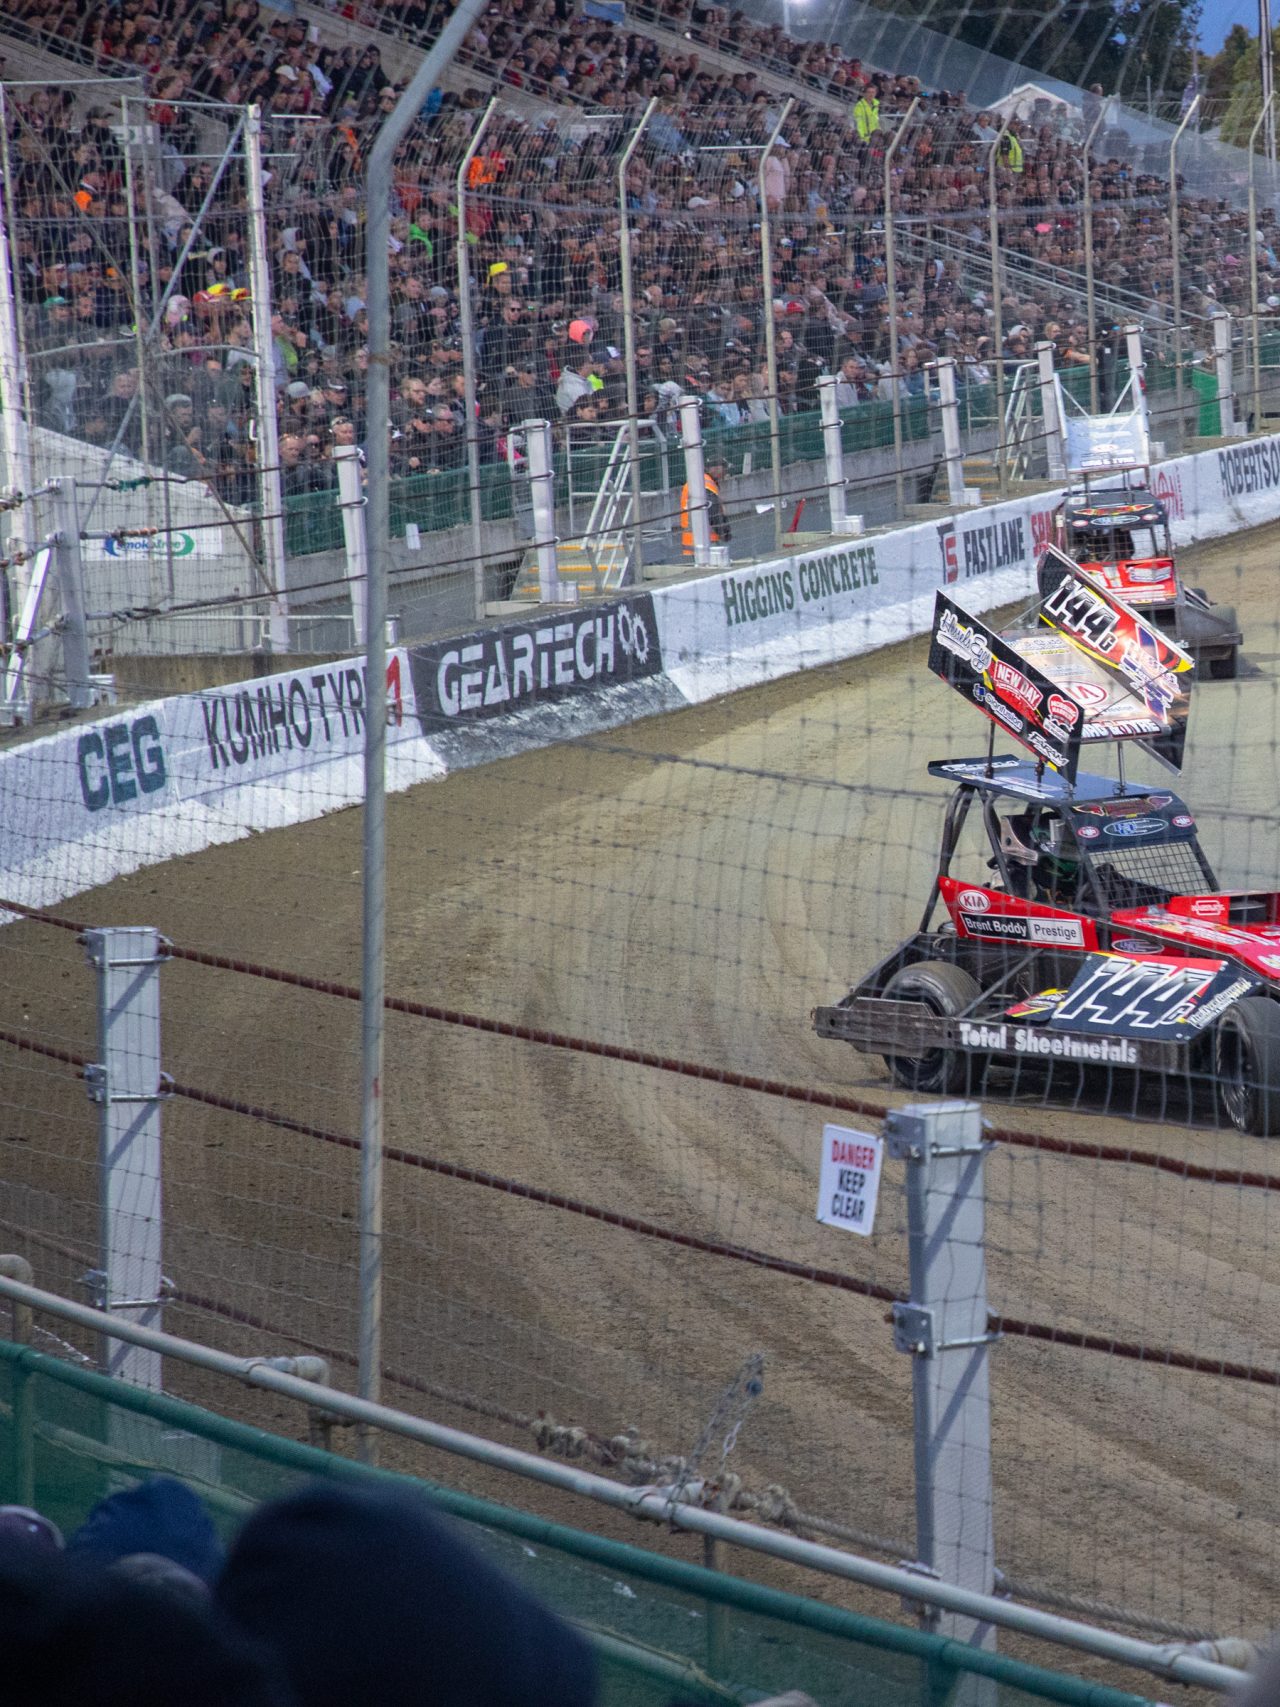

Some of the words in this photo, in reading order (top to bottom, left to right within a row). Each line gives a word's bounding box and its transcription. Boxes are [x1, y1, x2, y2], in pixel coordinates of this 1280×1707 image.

[963, 517, 1025, 578] FASTLANE
[721, 570, 794, 627] HIGGINS
[800, 547, 879, 602] CONCRETE
[437, 615, 614, 717] GEARTECH
[996, 664, 1022, 693] NEW
[1021, 681, 1040, 705] DAY
[201, 677, 313, 770] KUMHO
[77, 715, 166, 813] CEG
[963, 895, 985, 908] KIA
[964, 917, 992, 930] Brent
[992, 920, 1028, 937] Boddy
[1033, 923, 1078, 941] Prestige
[959, 1022, 1007, 1049] Total
[1015, 1028, 1137, 1064] Sheetmetals
[831, 1139, 876, 1171] DANGER
[838, 1167, 866, 1195] KEEP
[831, 1193, 866, 1223] CLEAR
